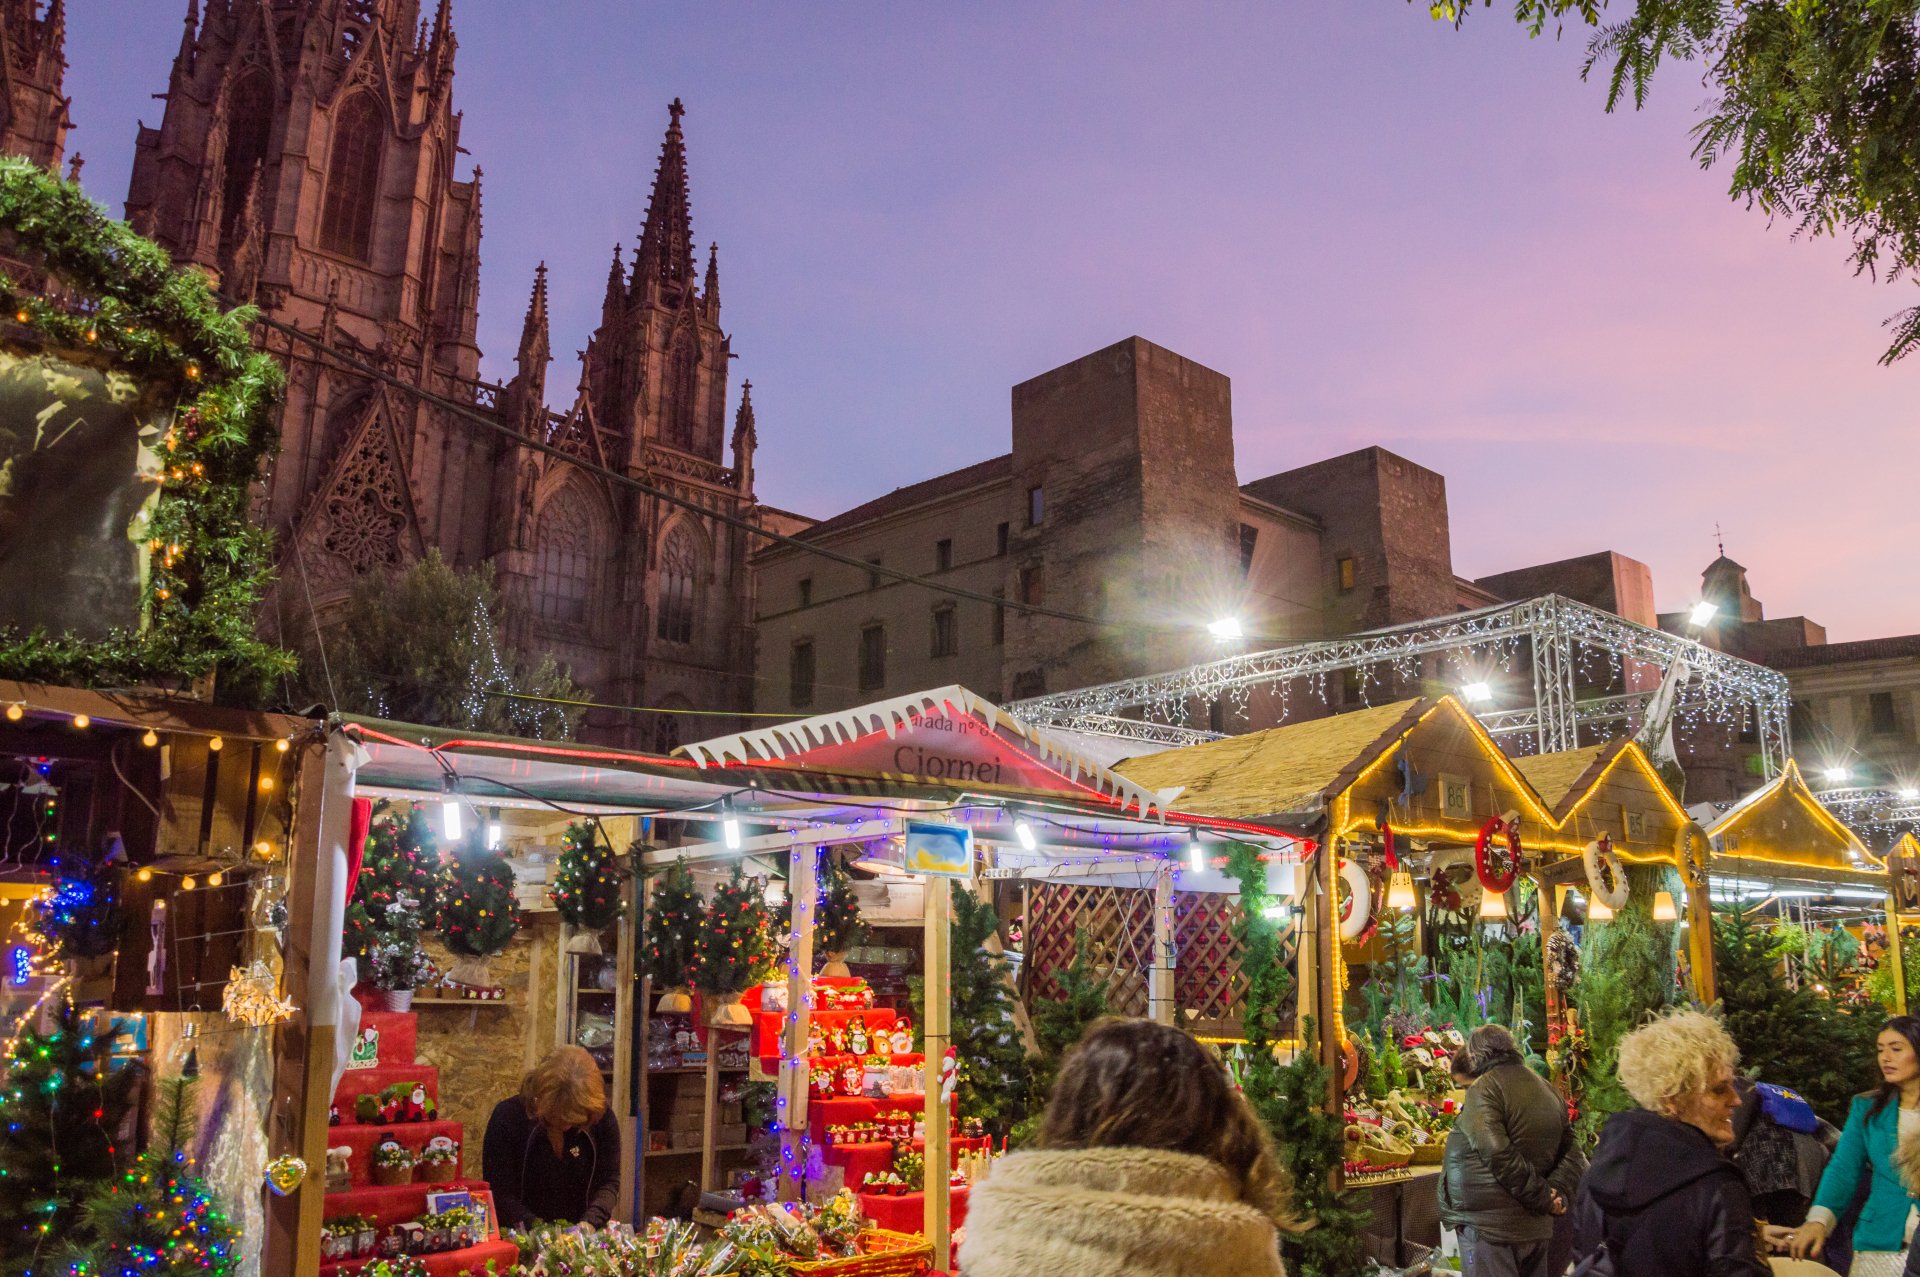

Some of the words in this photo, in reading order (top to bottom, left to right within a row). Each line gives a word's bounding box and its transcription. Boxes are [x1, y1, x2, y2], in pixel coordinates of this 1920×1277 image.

[898, 715, 953, 732] arada
[894, 745, 1001, 784] Ciornei
[1447, 785, 1464, 808] 86
